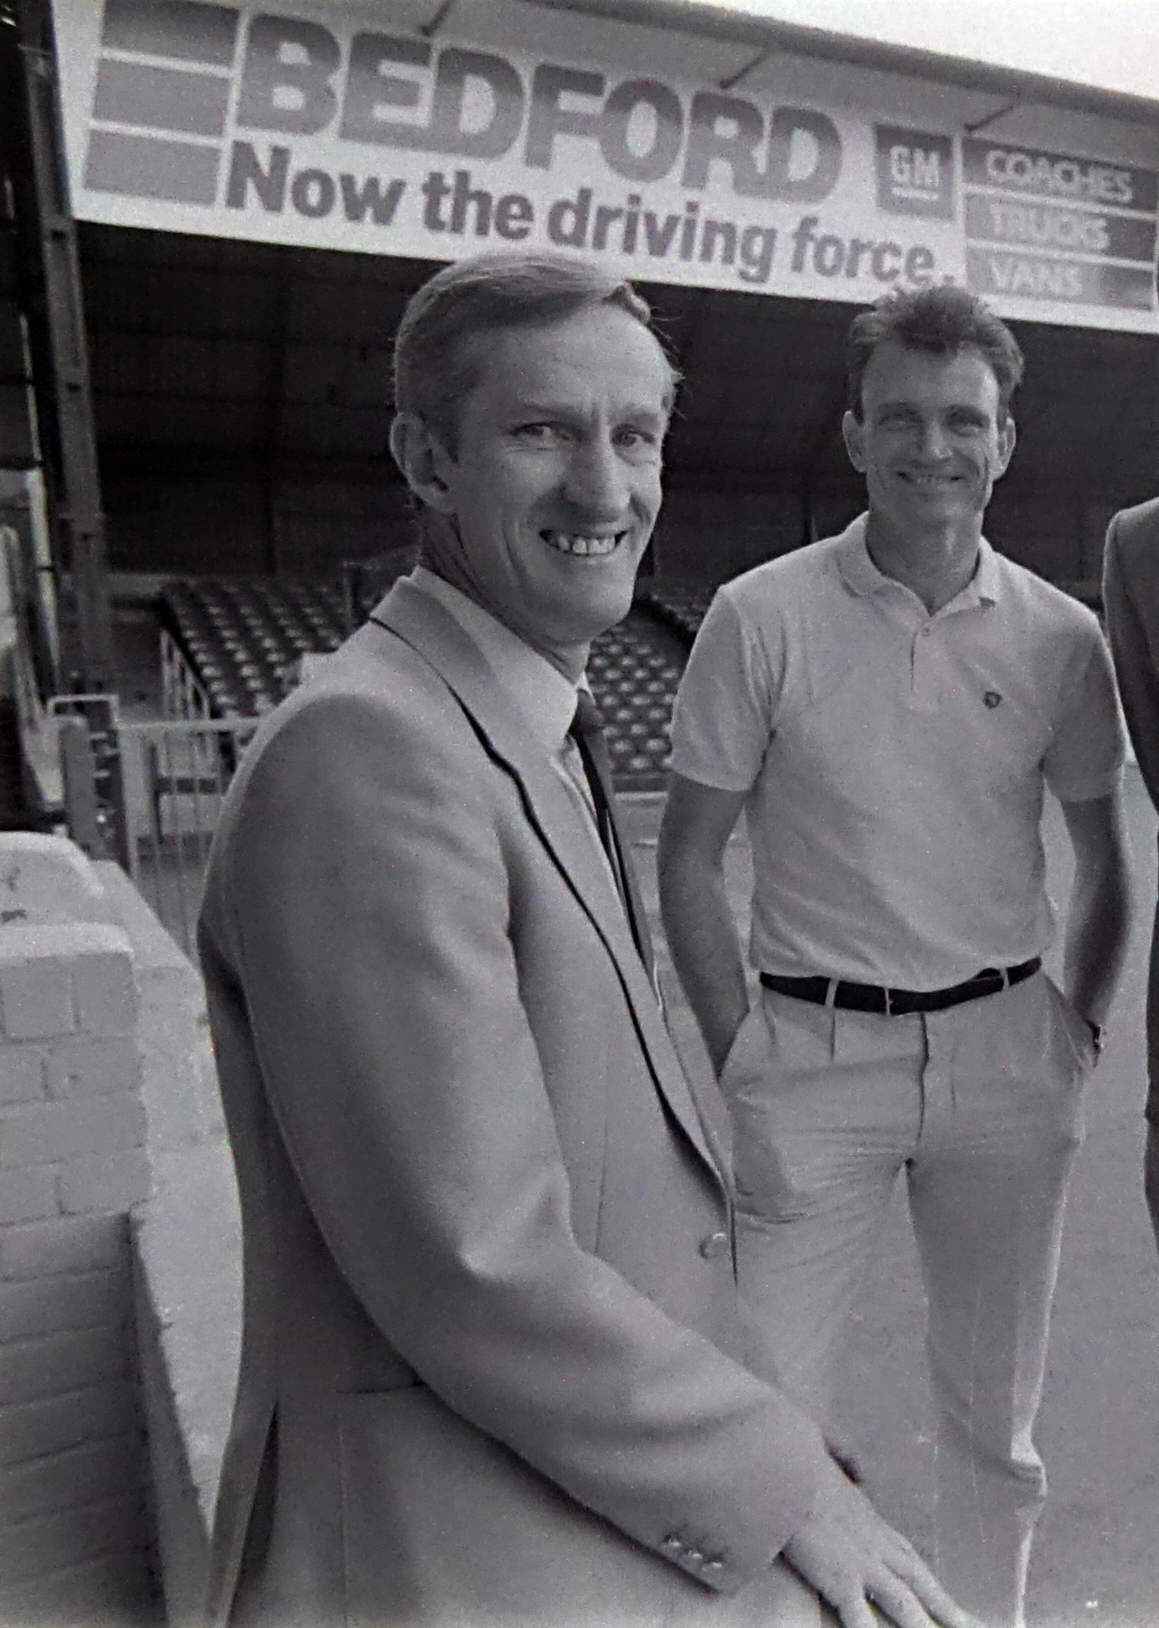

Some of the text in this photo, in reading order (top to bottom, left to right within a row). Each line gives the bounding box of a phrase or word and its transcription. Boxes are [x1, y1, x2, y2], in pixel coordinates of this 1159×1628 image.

[235, 13, 843, 203] BEDFORD
[890, 145, 940, 188] GM
[985, 149, 1133, 203] COACHES
[225, 139, 407, 227] Now
[421, 170, 534, 241] the
[547, 188, 779, 284] driving
[988, 257, 1084, 296] VANS
